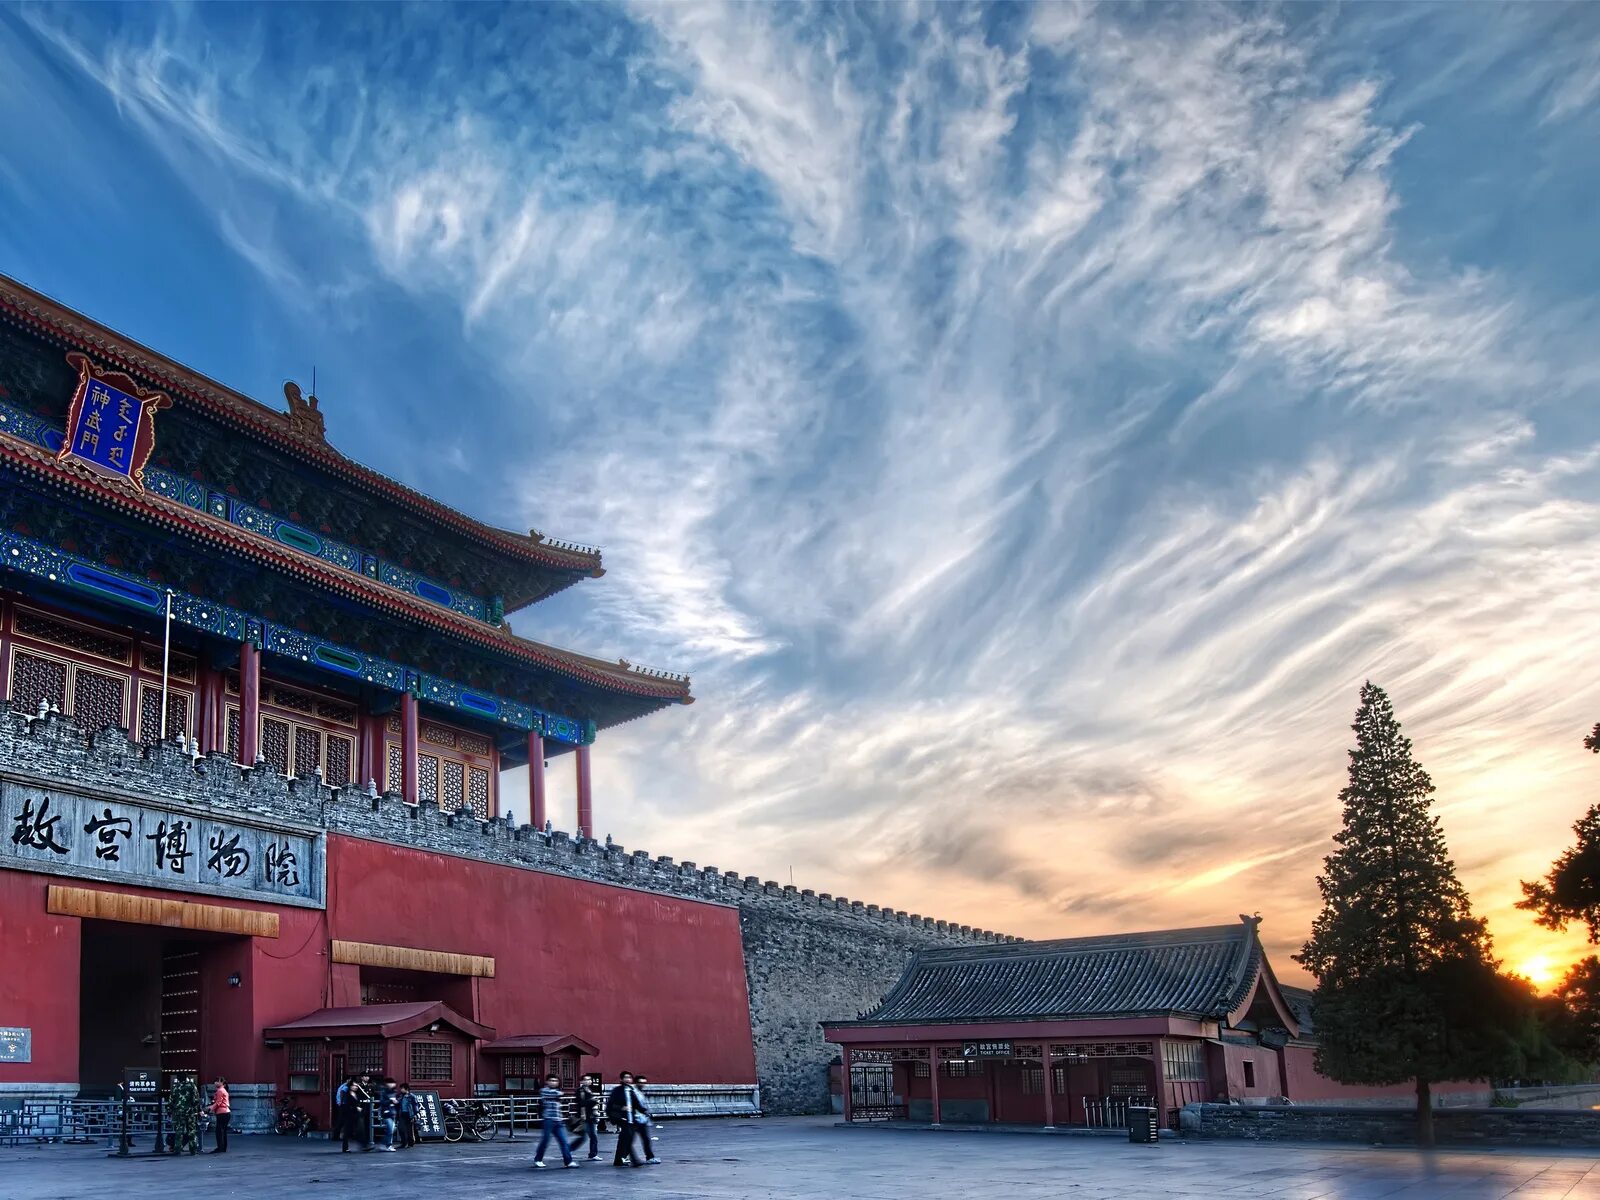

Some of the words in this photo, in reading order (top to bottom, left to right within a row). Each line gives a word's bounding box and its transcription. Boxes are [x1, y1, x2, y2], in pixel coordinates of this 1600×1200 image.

[80, 385, 111, 456] 神武門
[11, 796, 300, 887] 故宫博物院
